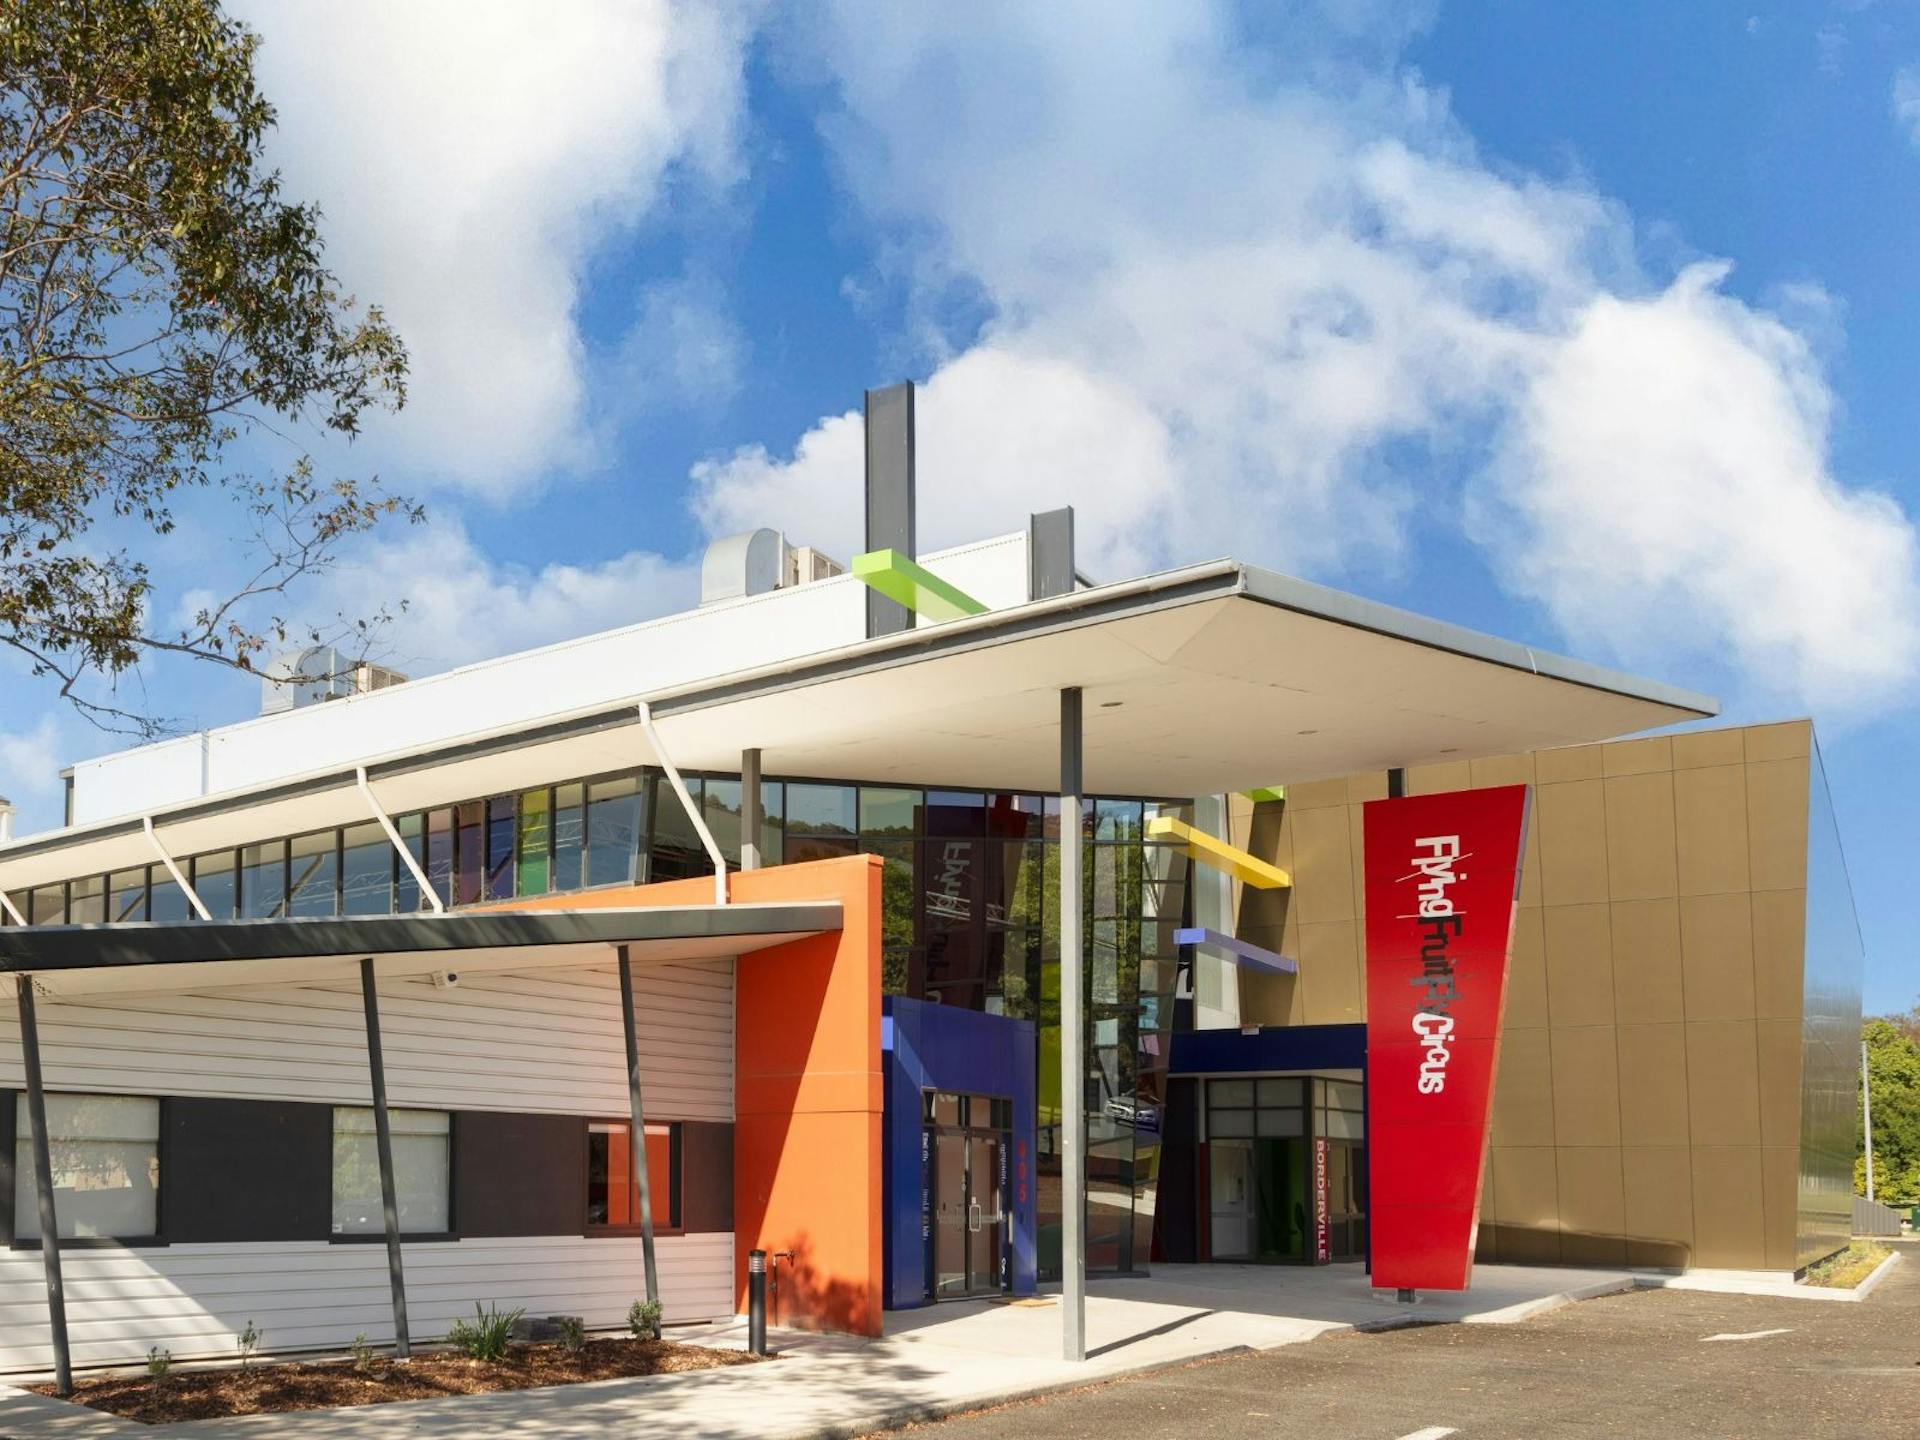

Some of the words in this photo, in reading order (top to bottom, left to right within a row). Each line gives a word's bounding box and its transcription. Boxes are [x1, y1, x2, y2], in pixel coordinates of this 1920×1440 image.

[1411, 835, 1467, 917] Flying
[1418, 915, 1461, 977] Fruit
[1412, 1012, 1455, 1094] Circus
[1316, 1140, 1326, 1260] BORDERVILLE
